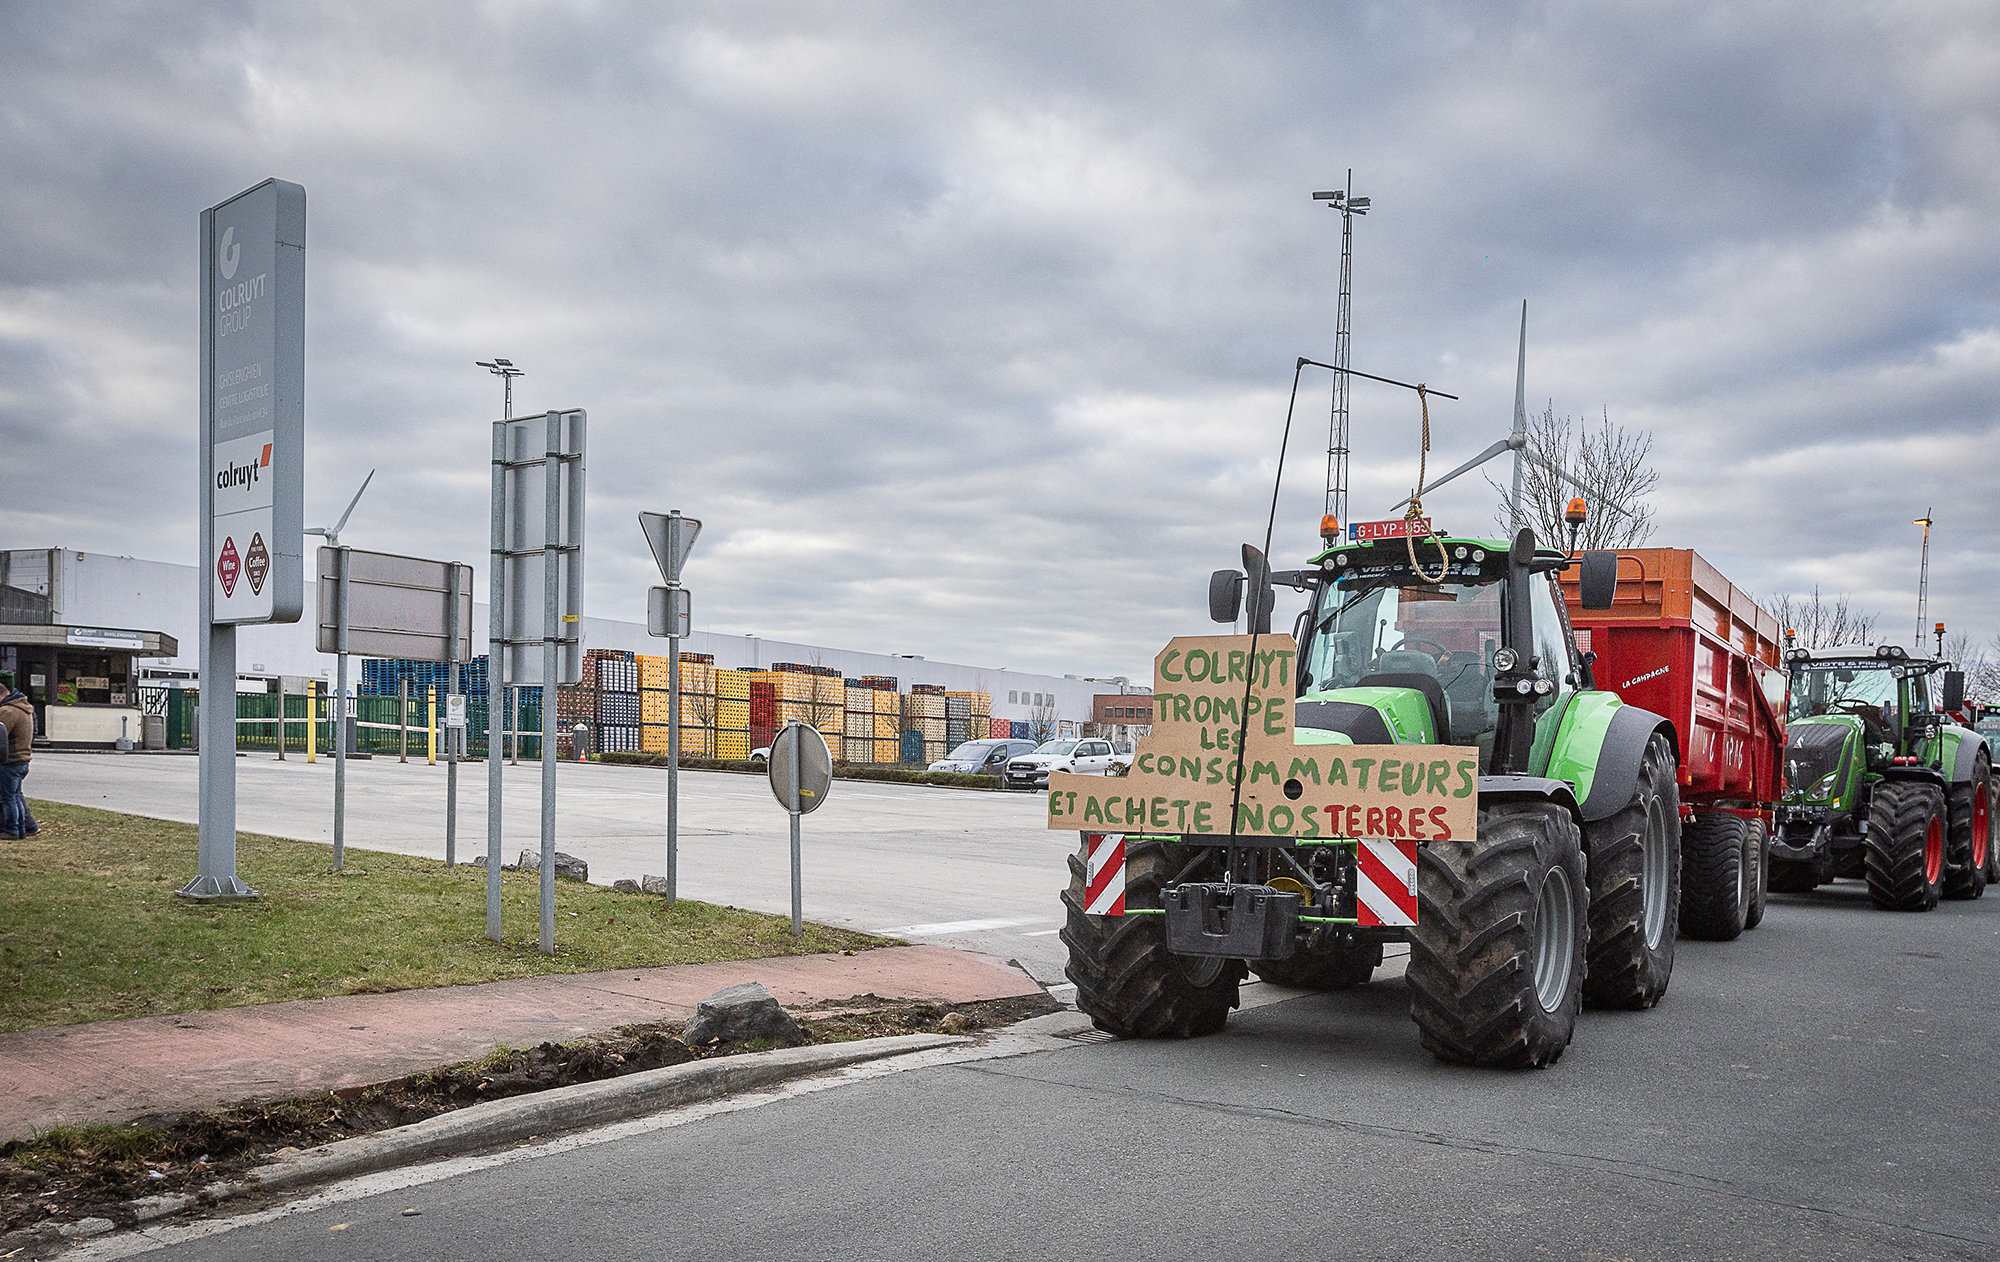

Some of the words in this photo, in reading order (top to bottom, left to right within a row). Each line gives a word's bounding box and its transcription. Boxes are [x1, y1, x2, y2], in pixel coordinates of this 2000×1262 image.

[219, 273, 266, 313] COLRUYT
[219, 305, 252, 337] GROUP
[216, 457, 259, 492] colruyt
[222, 559, 236, 571] Wine
[248, 555, 266, 568] Coffee
[1160, 649, 1296, 689] COLRUYT
[1622, 680, 1631, 689] LA
[1631, 665, 1670, 685] CAMPAGNE
[1153, 693, 1286, 736] TROMPE
[1200, 726, 1248, 755] LES
[1137, 752, 1477, 798] CONSOMMATEURS
[1050, 790, 1078, 816] ET
[1083, 795, 1214, 833] ACHETE
[1236, 802, 1320, 837] NOS
[1323, 804, 1452, 841] TERRES
